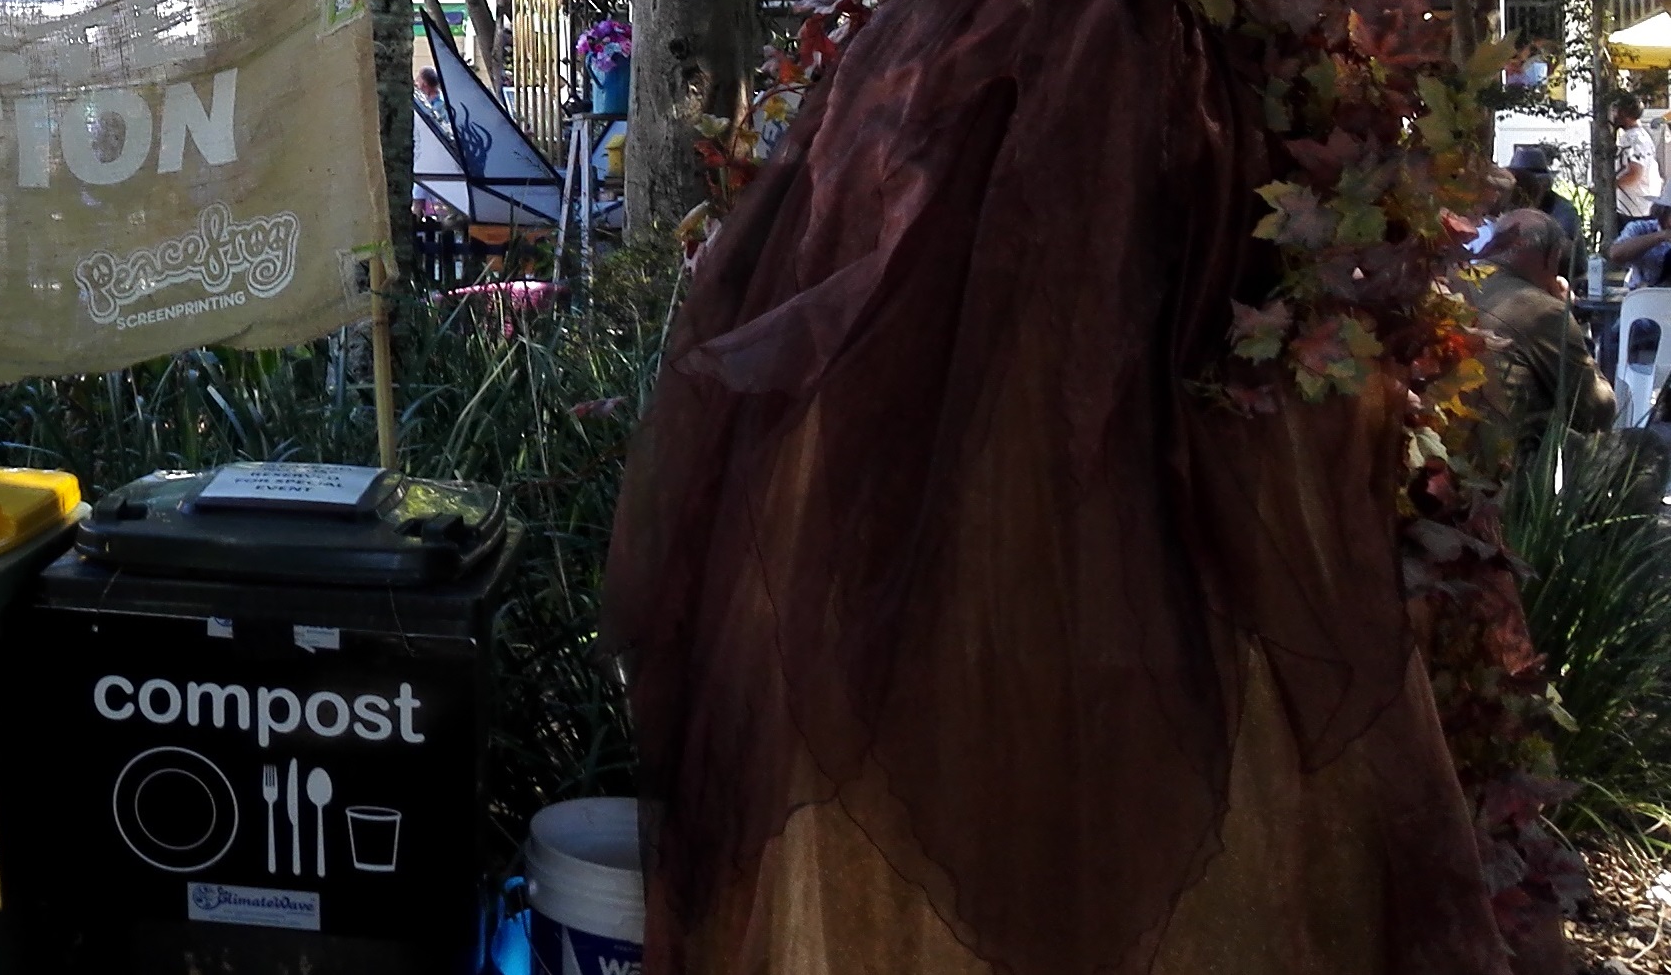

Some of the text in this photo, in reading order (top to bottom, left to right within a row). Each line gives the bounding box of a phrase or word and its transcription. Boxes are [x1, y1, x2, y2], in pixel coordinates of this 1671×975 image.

[116, 291, 246, 331] SCREENPRINTING
[255, 485, 312, 493] EVENT
[94, 674, 425, 748] compost
